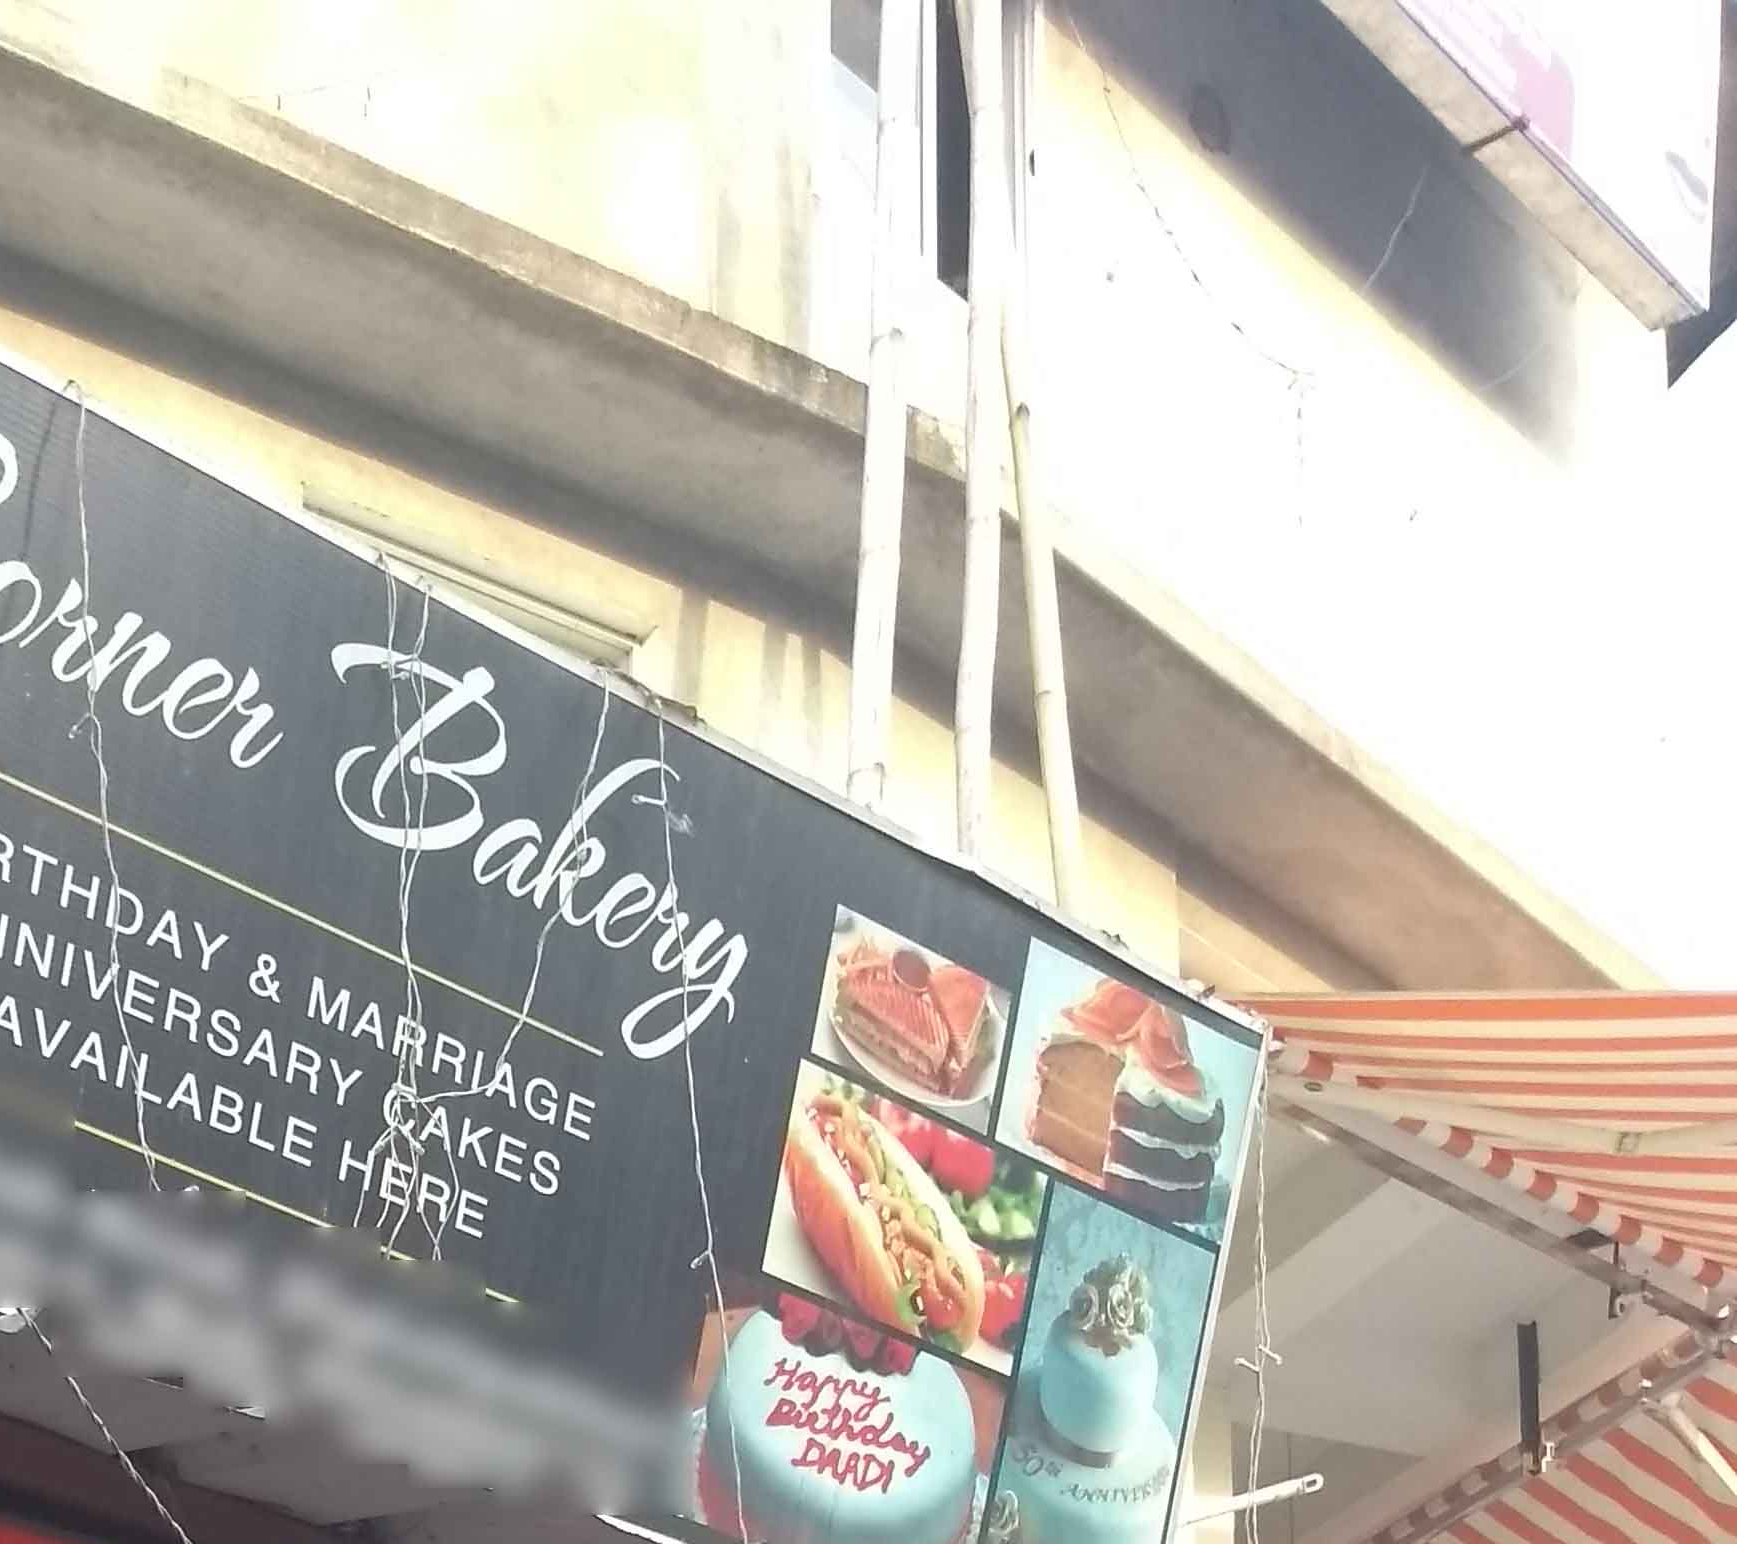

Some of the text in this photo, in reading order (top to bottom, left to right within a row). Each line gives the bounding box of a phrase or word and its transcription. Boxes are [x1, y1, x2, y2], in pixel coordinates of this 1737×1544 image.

[331, 642, 749, 1060] Bakery
[248, 953, 281, 1003] &
[307, 976, 596, 1141] MARRIAGE
[339, 1138, 489, 1238] HERE
[383, 1084, 562, 1196] CAKES
[764, 1357, 891, 1422] Happy
